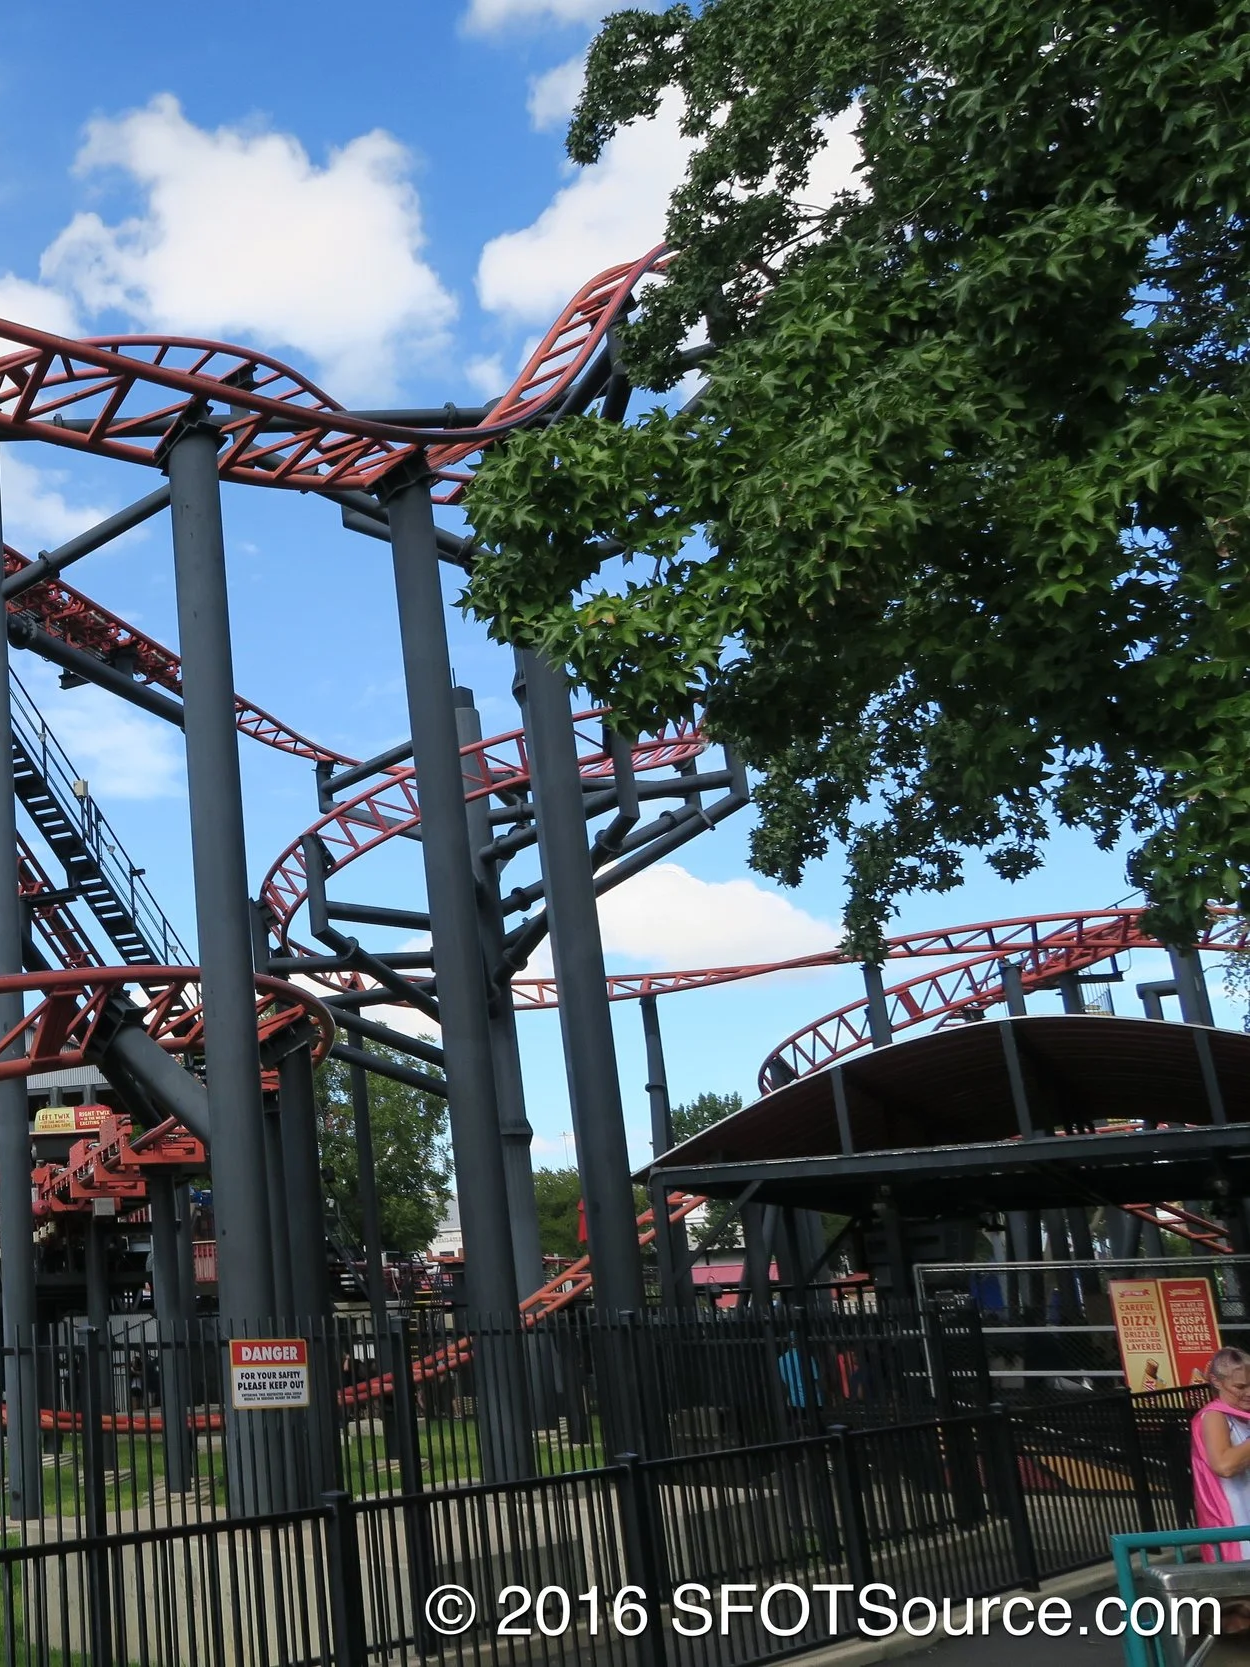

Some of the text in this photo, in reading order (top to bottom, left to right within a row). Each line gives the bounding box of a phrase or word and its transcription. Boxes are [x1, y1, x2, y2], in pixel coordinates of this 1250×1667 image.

[1121, 1315, 1157, 1326] DIZZY
[1172, 1316, 1207, 1324] CRISPY
[1174, 1325, 1210, 1333] COOKIE
[1176, 1333, 1212, 1341] CENTER
[241, 1346, 299, 1361] DANGER
[240, 1370, 301, 1380] FOR YOUR SAFETY
[237, 1380, 304, 1391] PLEASE KEEP OUT
